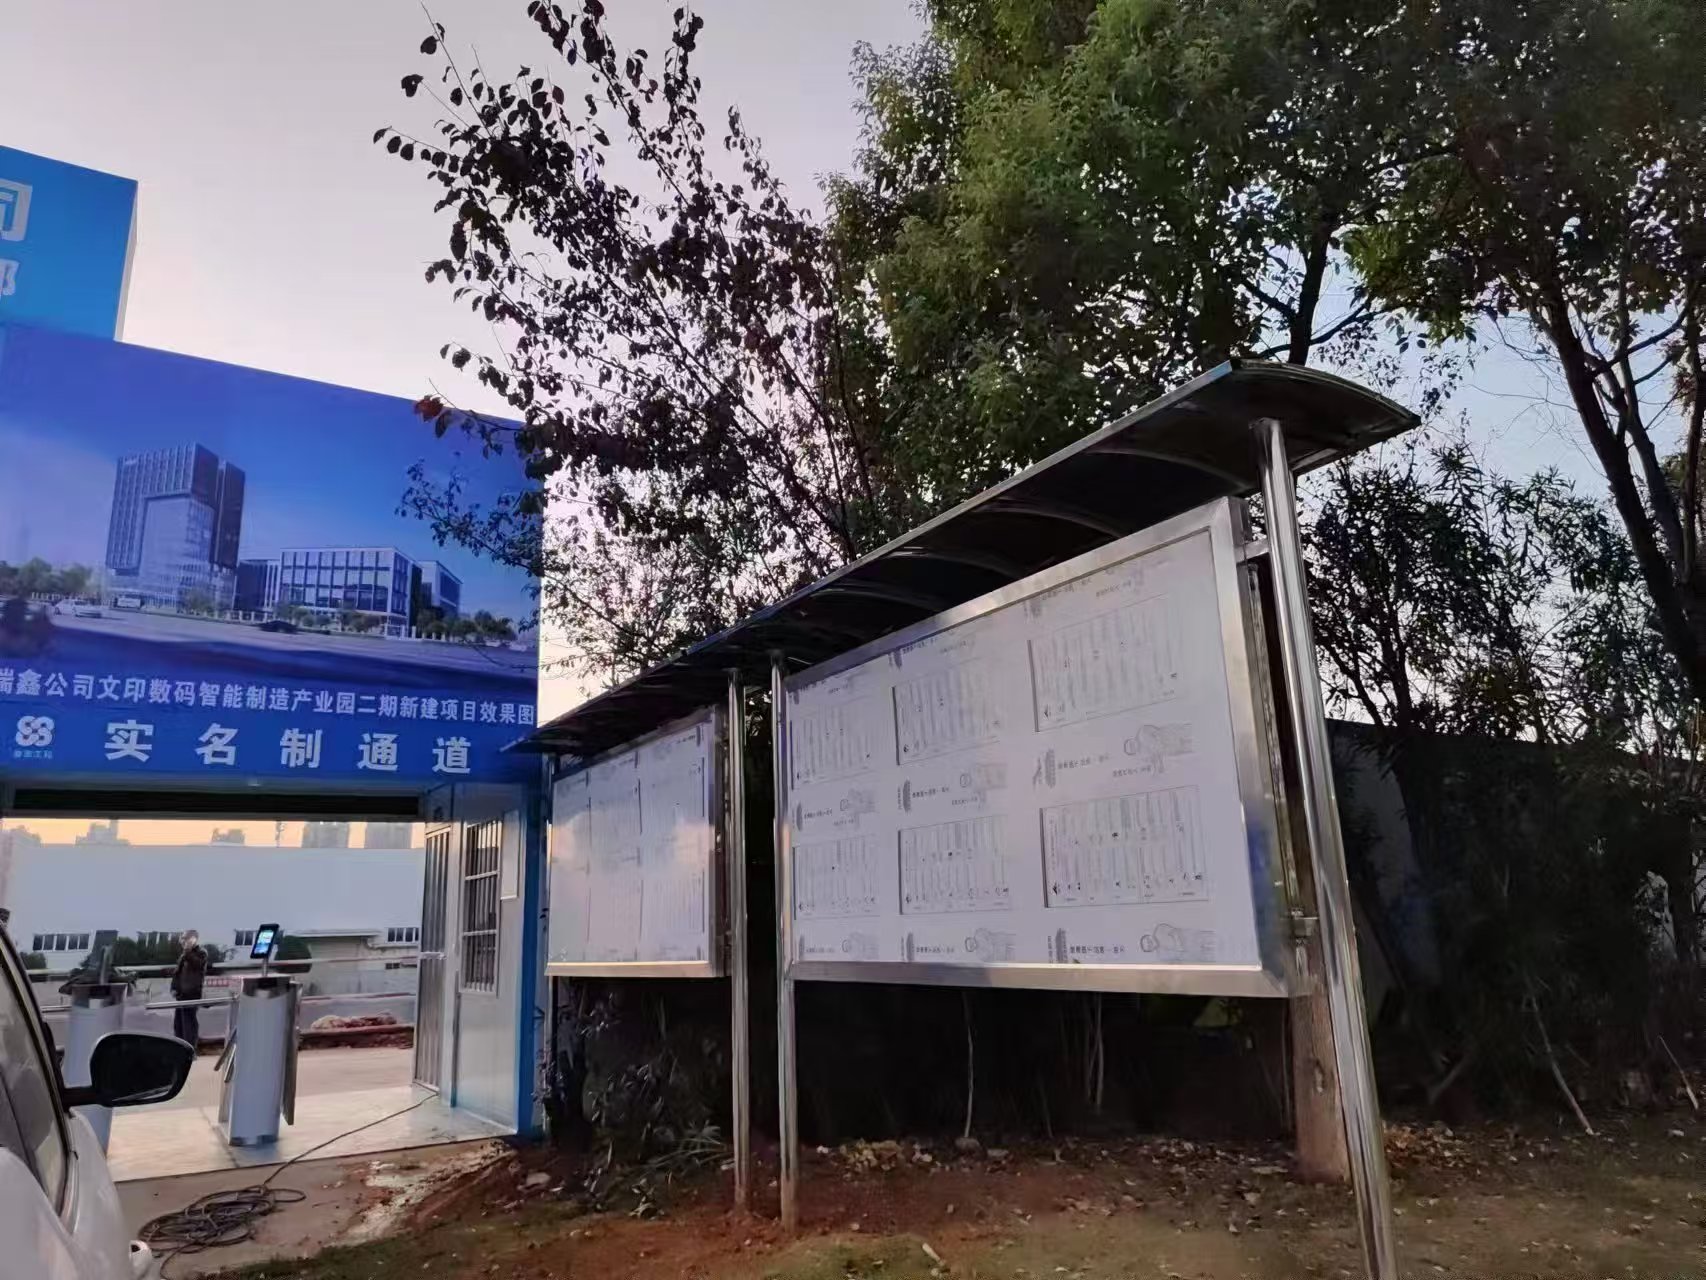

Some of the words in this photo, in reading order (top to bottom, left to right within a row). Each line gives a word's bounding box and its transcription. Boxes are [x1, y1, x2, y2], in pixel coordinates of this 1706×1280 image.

[104, 719, 471, 774] 实名制通道
